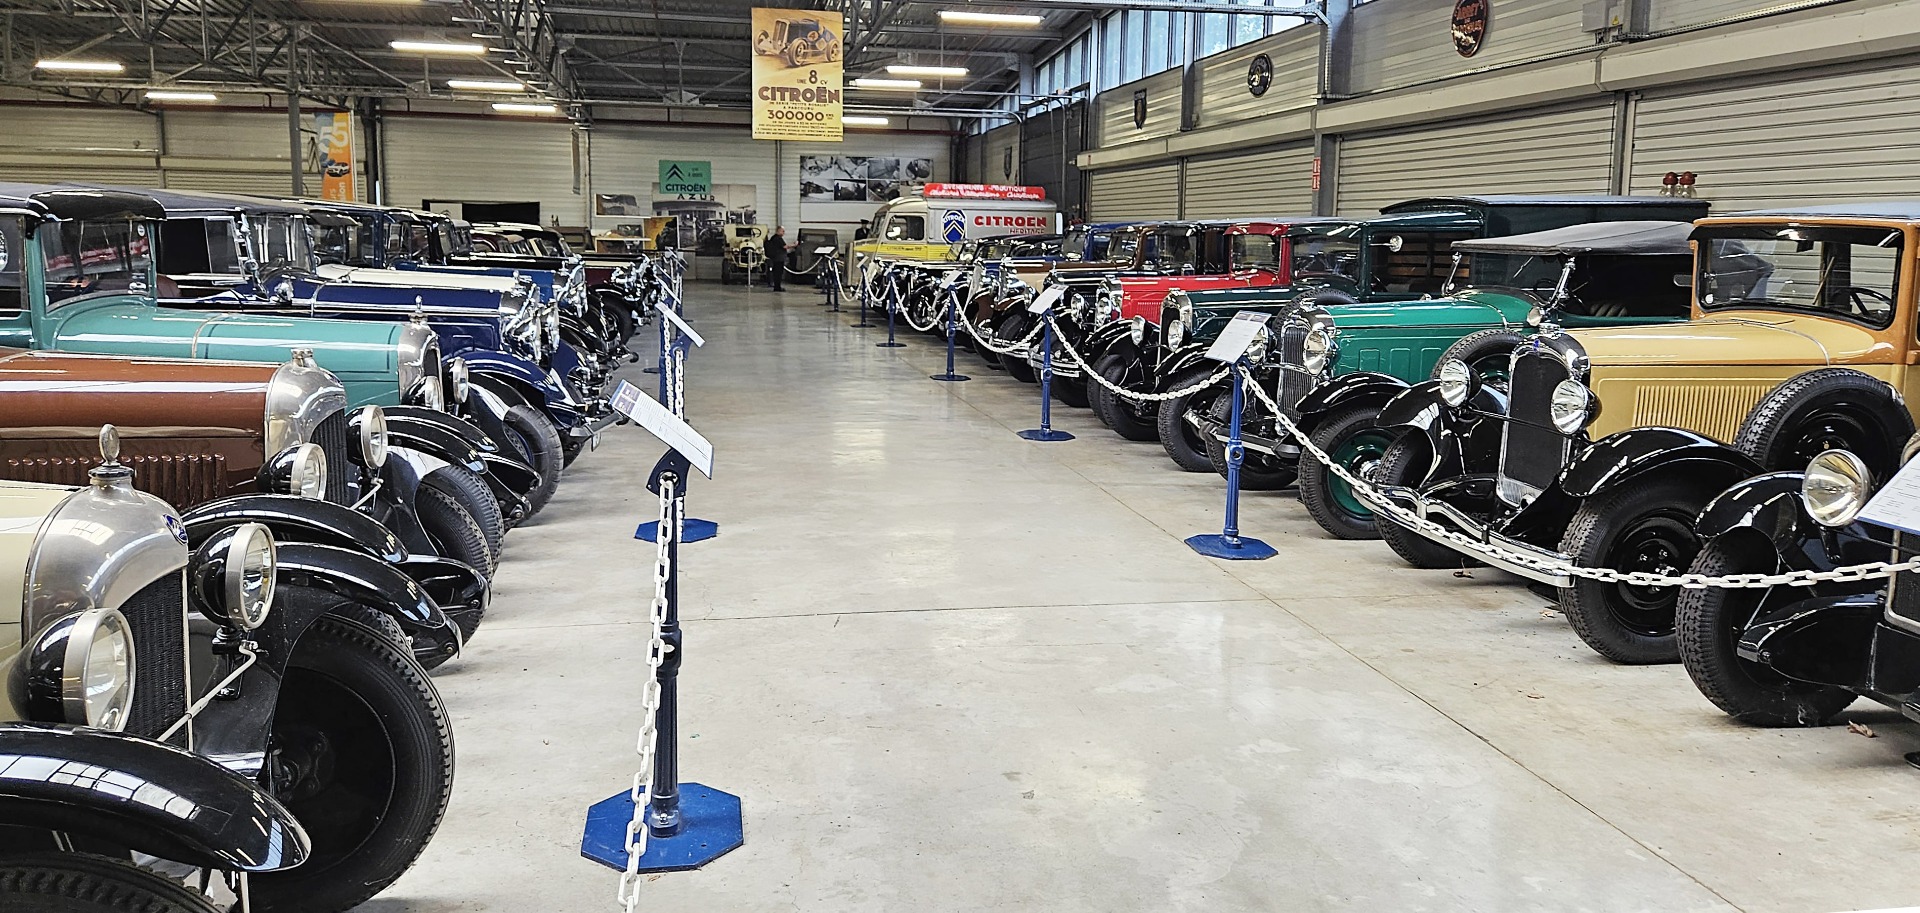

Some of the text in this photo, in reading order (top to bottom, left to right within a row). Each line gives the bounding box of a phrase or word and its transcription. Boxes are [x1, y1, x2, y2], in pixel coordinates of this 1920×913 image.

[808, 69, 818, 84] 8
[758, 86, 840, 104] CITROËN
[767, 109, 824, 121] 300000
[665, 183, 706, 192] CITROËN
